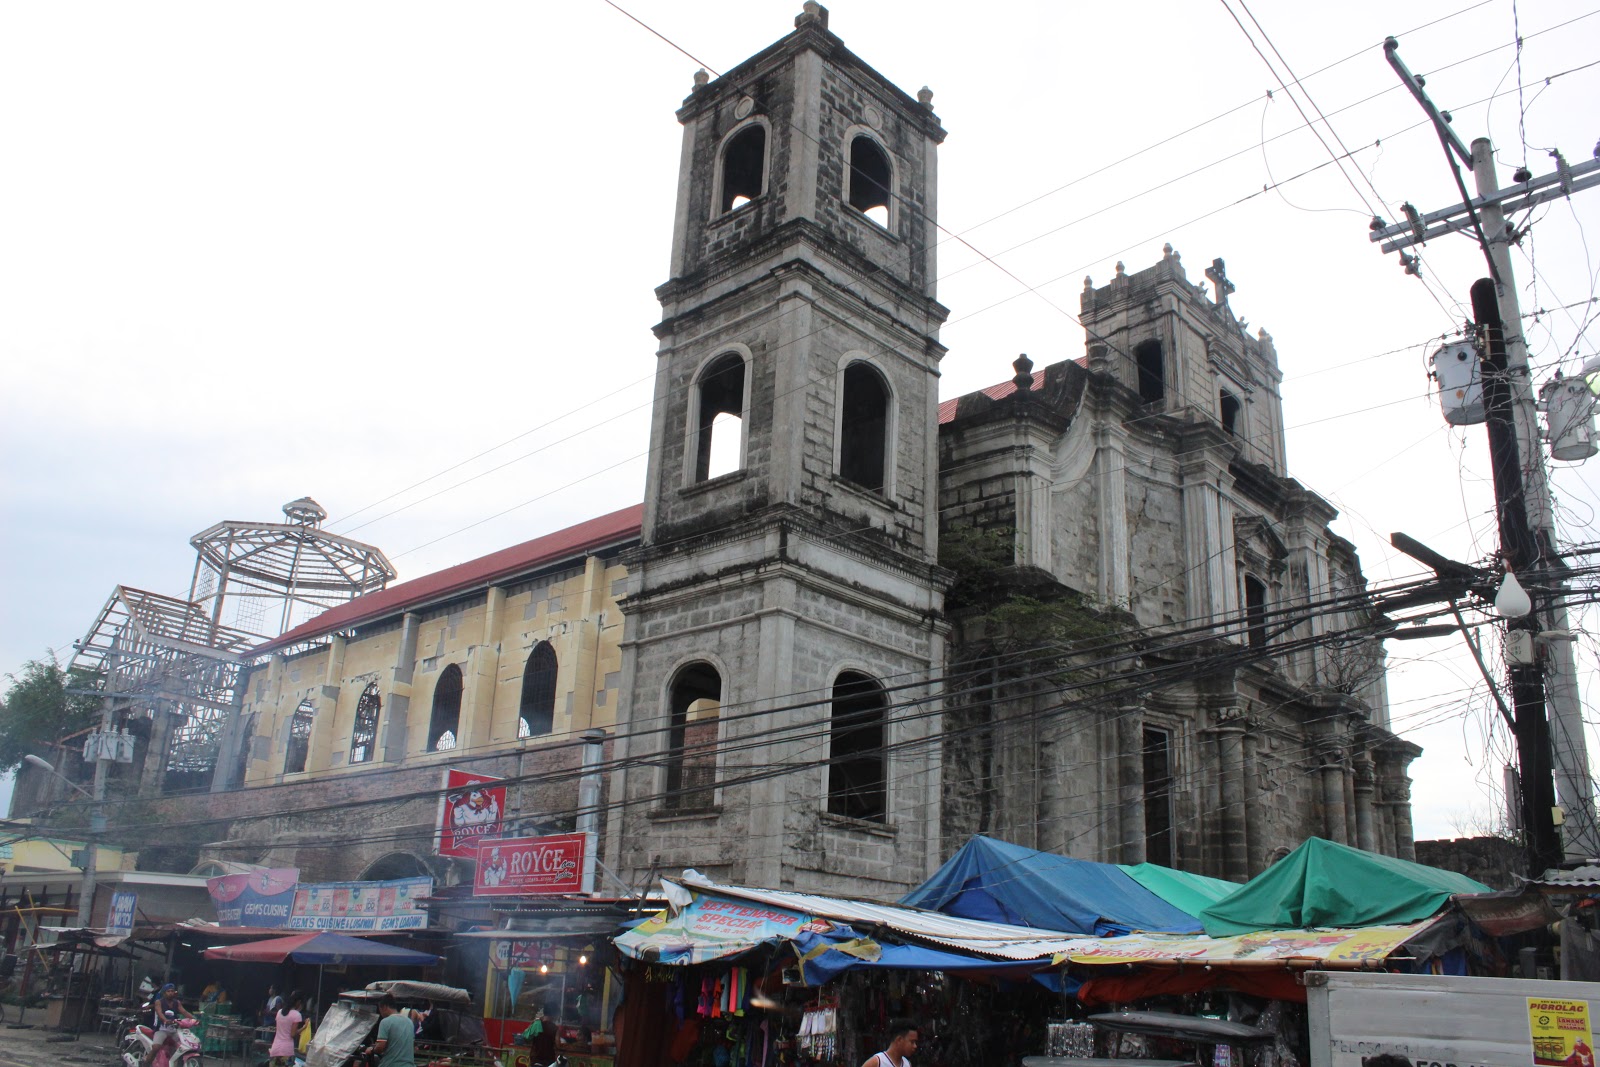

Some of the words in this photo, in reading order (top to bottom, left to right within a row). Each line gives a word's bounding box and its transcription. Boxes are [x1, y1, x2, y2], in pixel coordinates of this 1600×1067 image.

[453, 825, 491, 839] ROYCE
[510, 845, 564, 874] ROYCE
[244, 903, 263, 915] GEM'S
[263, 904, 288, 917] CUISINE
[698, 899, 799, 926] SEPTEMBER
[290, 917, 315, 929] GEM'S
[316, 917, 345, 929] CUISINE
[380, 917, 398, 929] GEM'S
[1530, 1003, 1584, 1013] PIGROLAC
